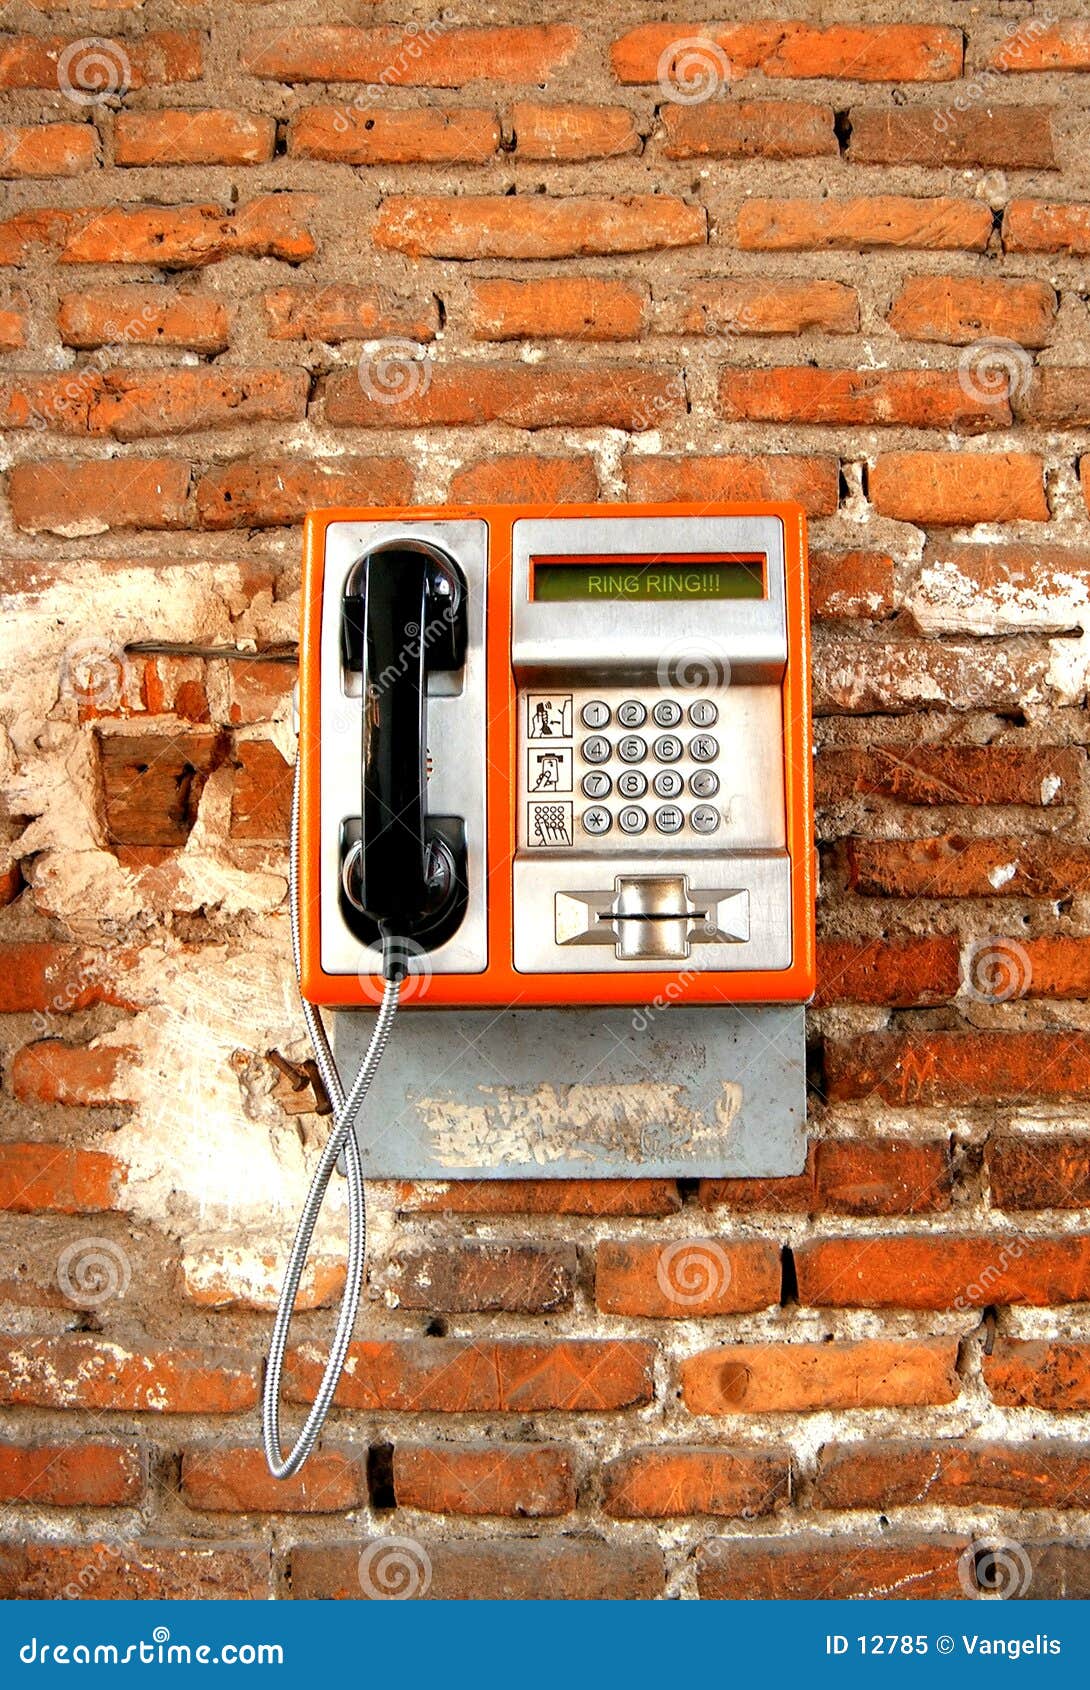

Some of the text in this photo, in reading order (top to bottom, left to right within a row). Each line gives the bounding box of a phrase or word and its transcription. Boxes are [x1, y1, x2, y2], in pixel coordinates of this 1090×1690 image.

[588, 574, 720, 593] RING RING!!!
[593, 707, 600, 722] 1
[626, 706, 637, 721] 2
[661, 706, 673, 721] 3
[591, 740, 711, 757] 4 5 6 K
[592, 776, 674, 792] 7 8 9
